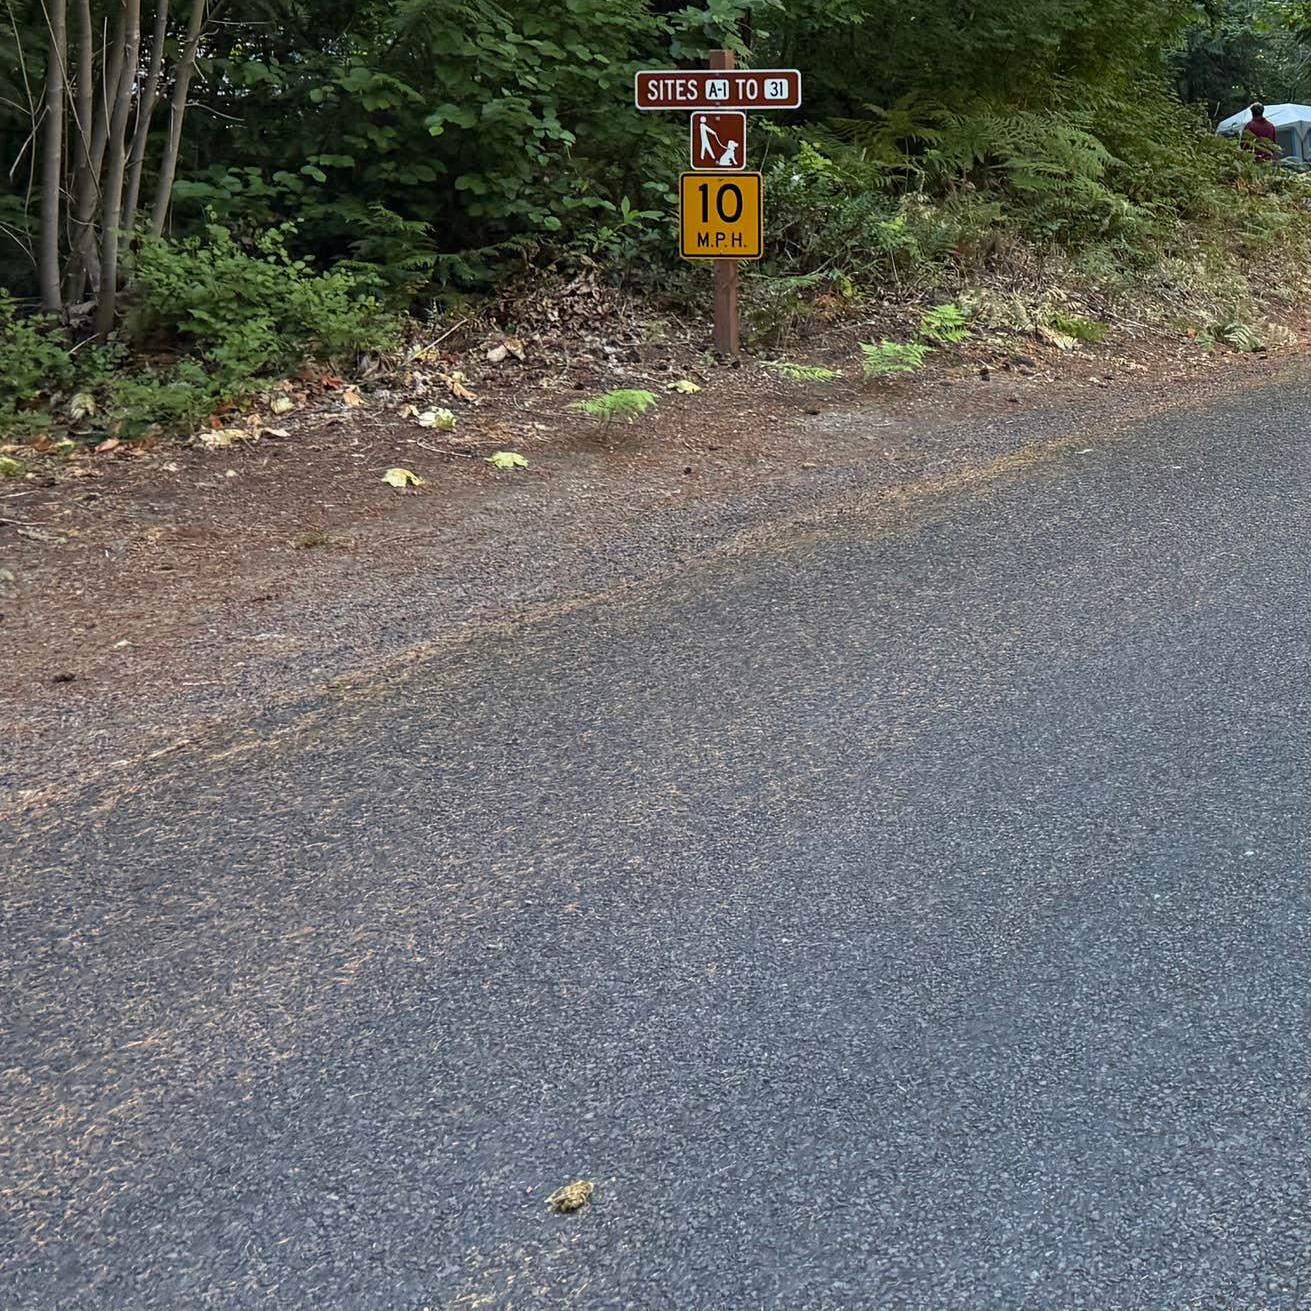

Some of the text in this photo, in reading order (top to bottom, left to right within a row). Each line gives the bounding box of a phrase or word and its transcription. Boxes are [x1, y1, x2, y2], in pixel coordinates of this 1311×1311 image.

[647, 79, 784, 101] SITES A-1 TO 31
[698, 183, 743, 224] 10
[697, 232, 748, 248] M.P.H.
